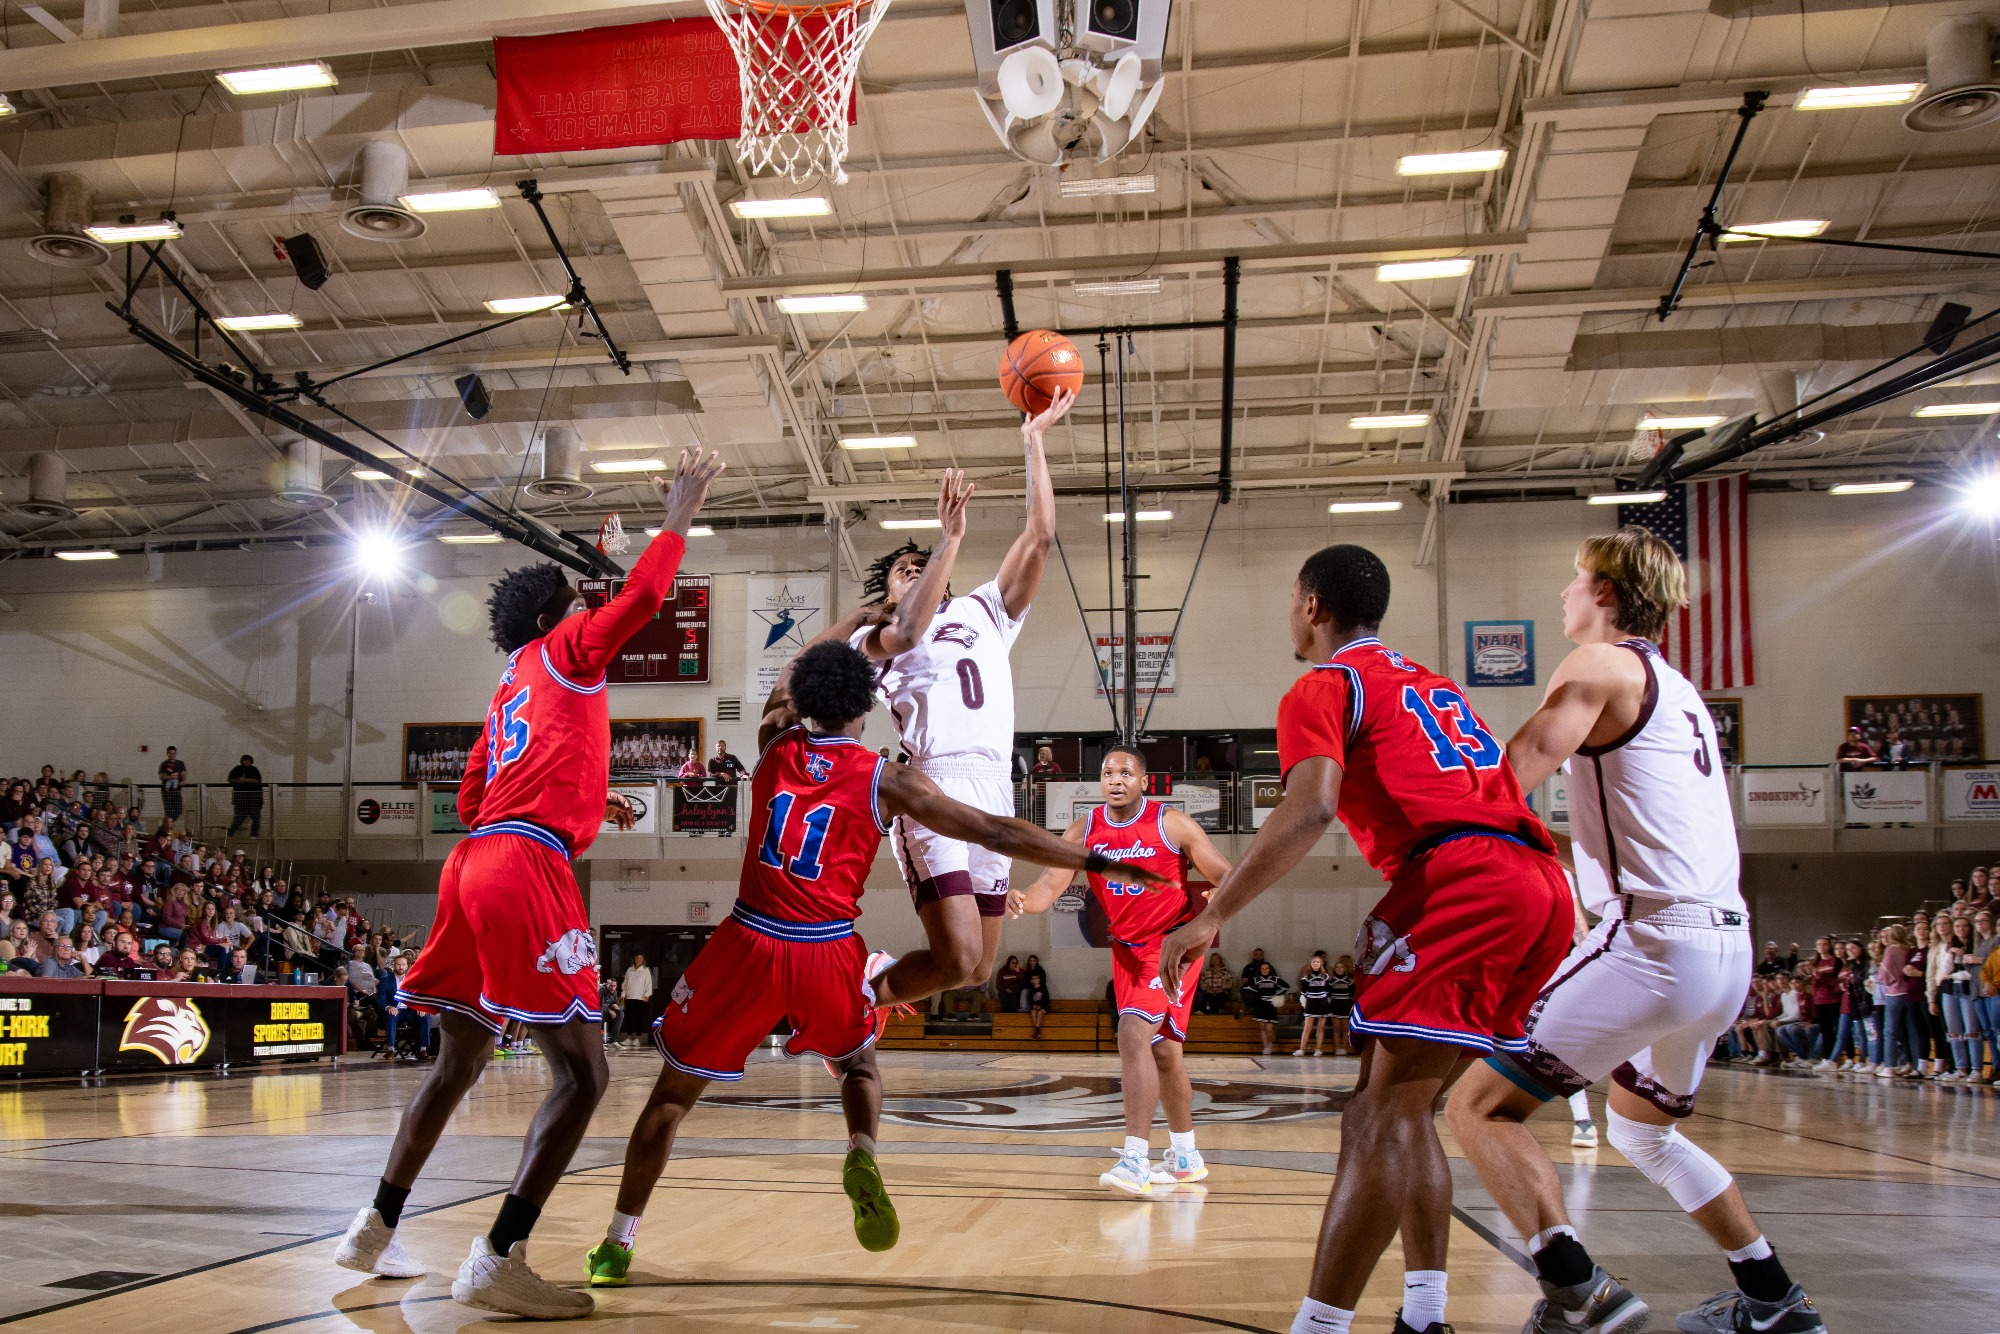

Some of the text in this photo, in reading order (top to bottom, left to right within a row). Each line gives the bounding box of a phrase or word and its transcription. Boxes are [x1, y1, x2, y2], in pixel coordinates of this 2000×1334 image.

[582, 581, 606, 590] HOME
[678, 578, 709, 587] VISITOR
[696, 589, 707, 607] 3
[675, 610, 696, 618] BONUS
[676, 621, 707, 629] TIMEOUTS
[687, 629, 696, 642] 5
[1136, 635, 1175, 646] PAINTIN
[1476, 634, 1521, 650] NAIA
[679, 652, 699, 660] FOULS
[1148, 651, 1175, 660] PAINTR
[1137, 660, 1171, 669] ATHLETS
[956, 657, 985, 710] 0
[486, 685, 530, 786] 15
[1402, 685, 1504, 772] 13
[1681, 709, 1712, 778] 3
[381, 802, 416, 810] ELITE
[433, 804, 458, 814] LEA
[758, 790, 836, 882] 11
[1093, 839, 1156, 861] Tougaloo
[990, 877, 1009, 892] FH
[18, 998, 32, 1011] TO
[271, 1002, 310, 1020] BREWER
[0, 1015, 50, 1038] -KIRK
[253, 1022, 325, 1043] SPORTS CENTER
